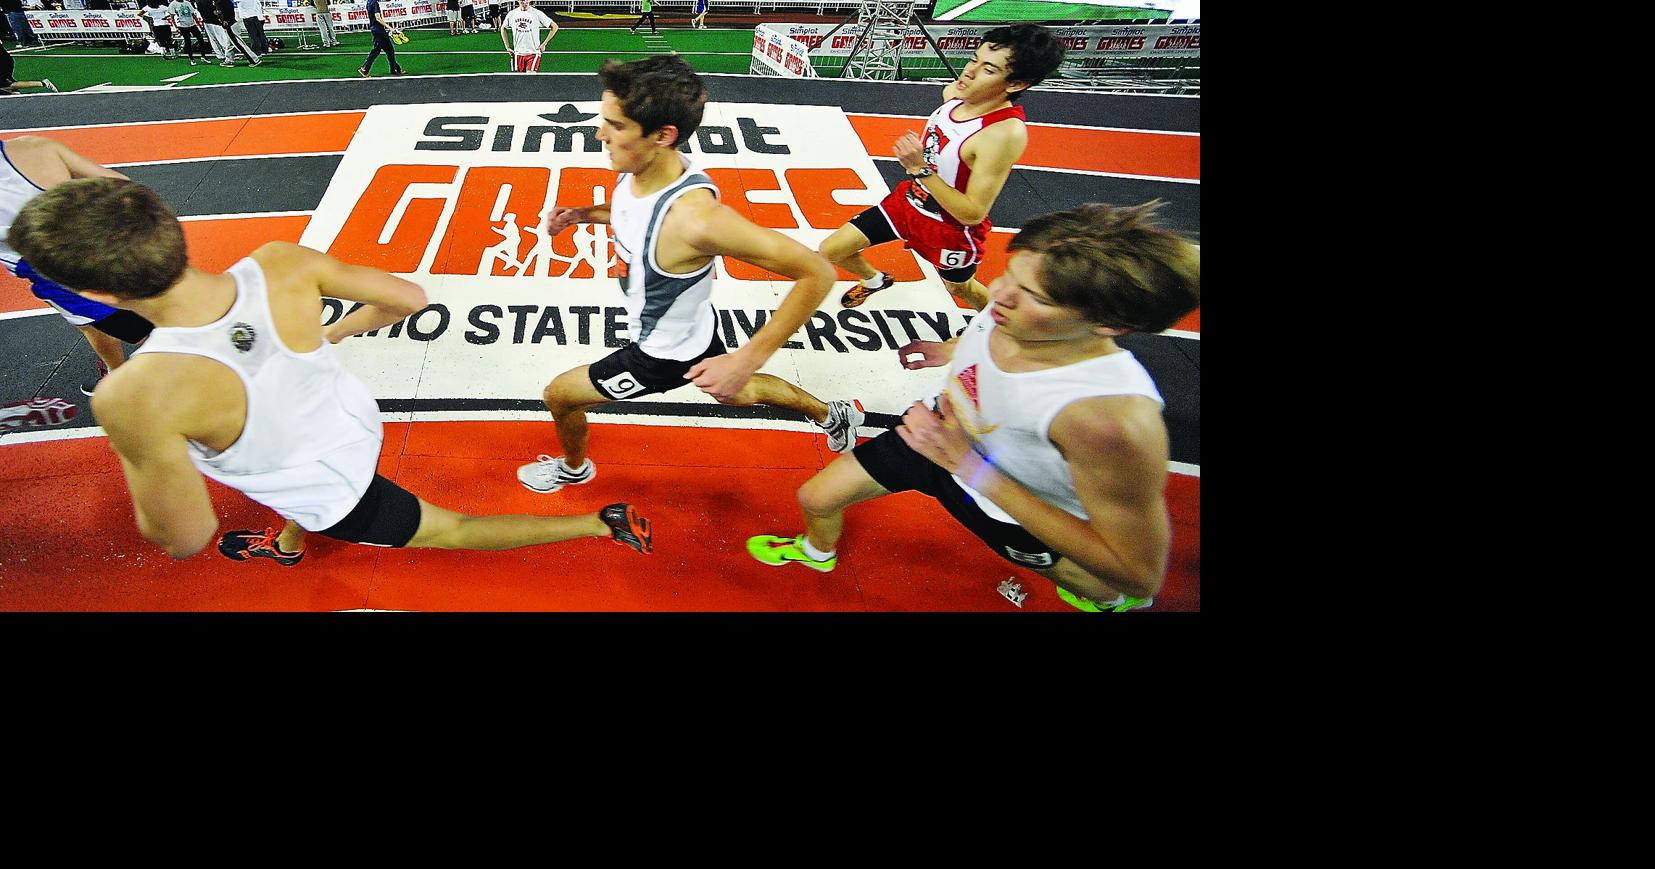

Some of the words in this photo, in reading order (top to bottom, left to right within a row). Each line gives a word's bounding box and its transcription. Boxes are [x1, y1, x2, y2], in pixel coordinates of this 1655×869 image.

[383, 8, 407, 17] GAMES
[47, 19, 77, 27] GAMES
[81, 19, 110, 27] GAMES
[115, 19, 142, 27] GAMES
[276, 14, 305, 23] GAMES
[790, 26, 818, 35] Simplot
[948, 27, 977, 36] Simplot
[1056, 28, 1088, 36] Simplot
[1112, 27, 1145, 36] Simplot
[1170, 26, 1200, 35] Simplo
[937, 37, 981, 49] GAMES
[1096, 36, 1147, 50] GAMES
[1153, 36, 1200, 49] GAME
[414, 116, 790, 155] Simot
[946, 252, 959, 266] 6
[464, 304, 631, 348] STATE
[718, 308, 951, 354] IVRSITY
[609, 378, 635, 394] 9
